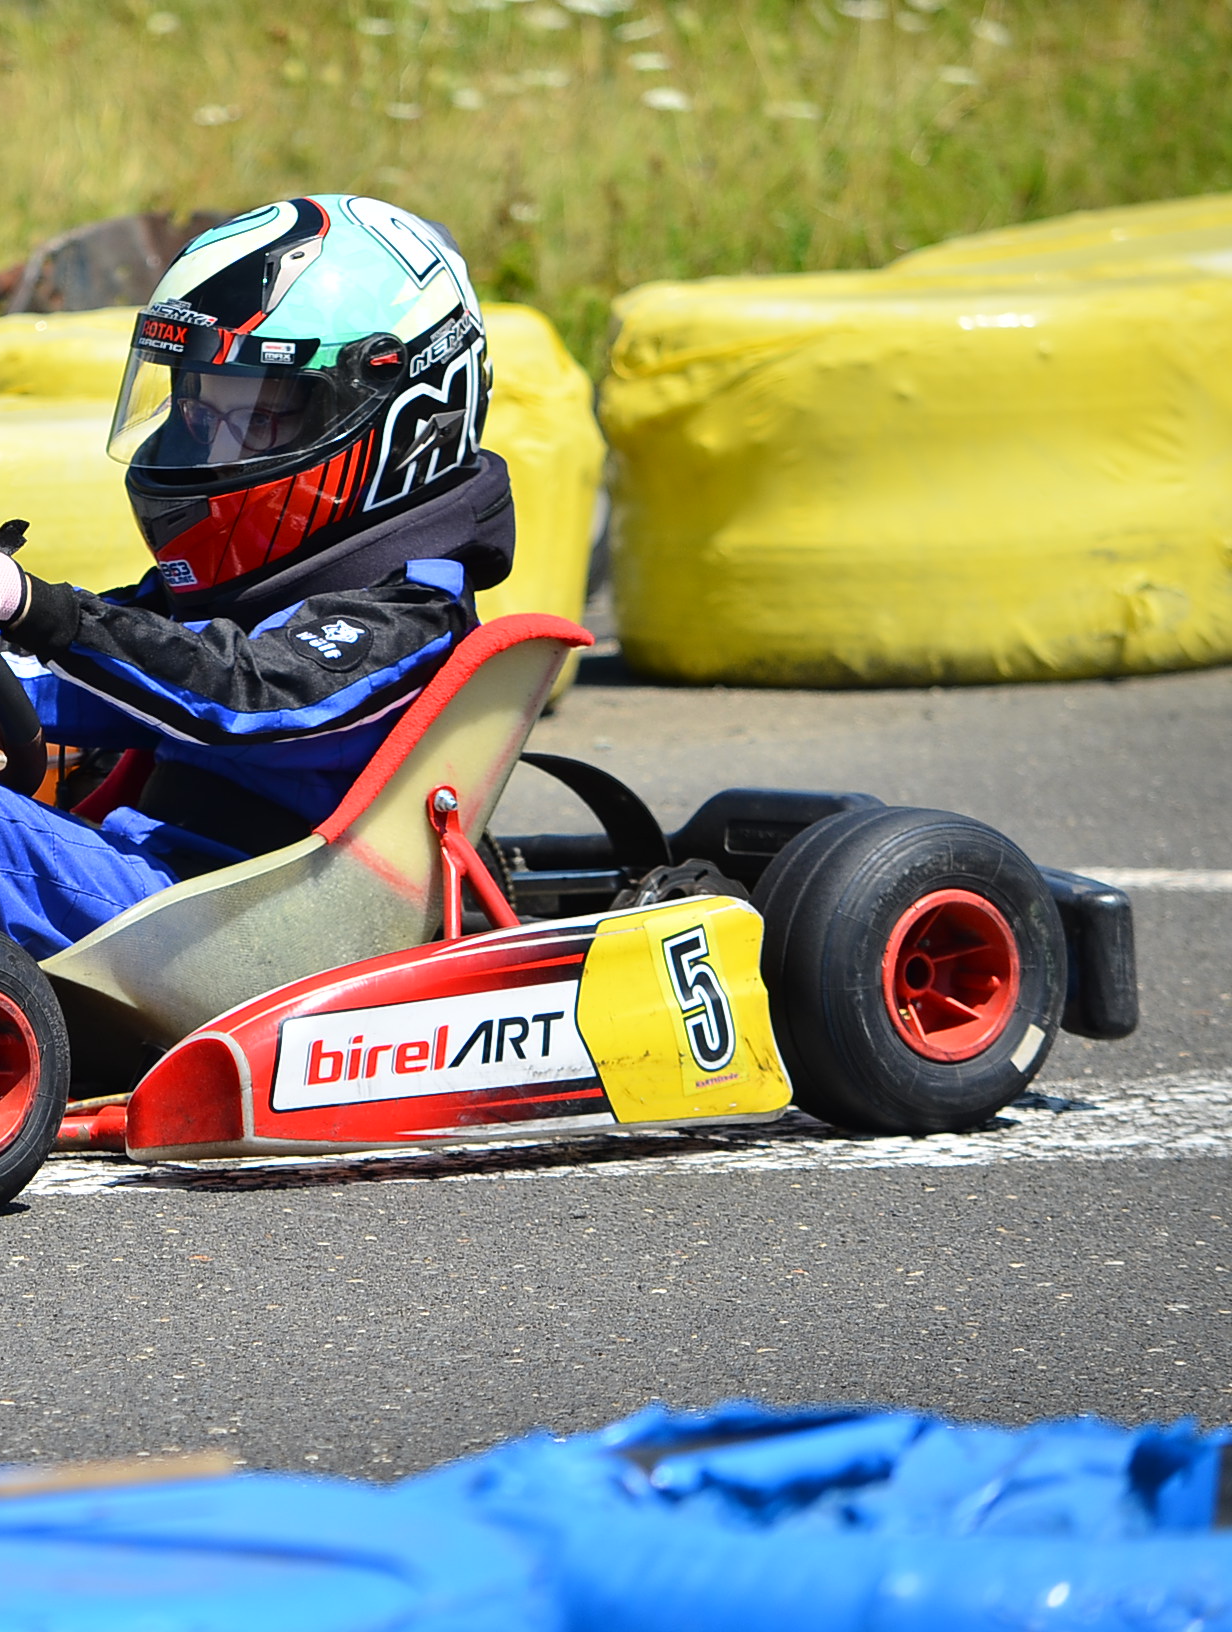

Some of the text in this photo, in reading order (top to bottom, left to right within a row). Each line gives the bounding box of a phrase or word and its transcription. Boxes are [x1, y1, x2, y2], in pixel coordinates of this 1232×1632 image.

[138, 337, 184, 353] RACING
[142, 320, 188, 344] ROTAX
[661, 923, 737, 1073] 5
[304, 1010, 565, 1086] birelART
